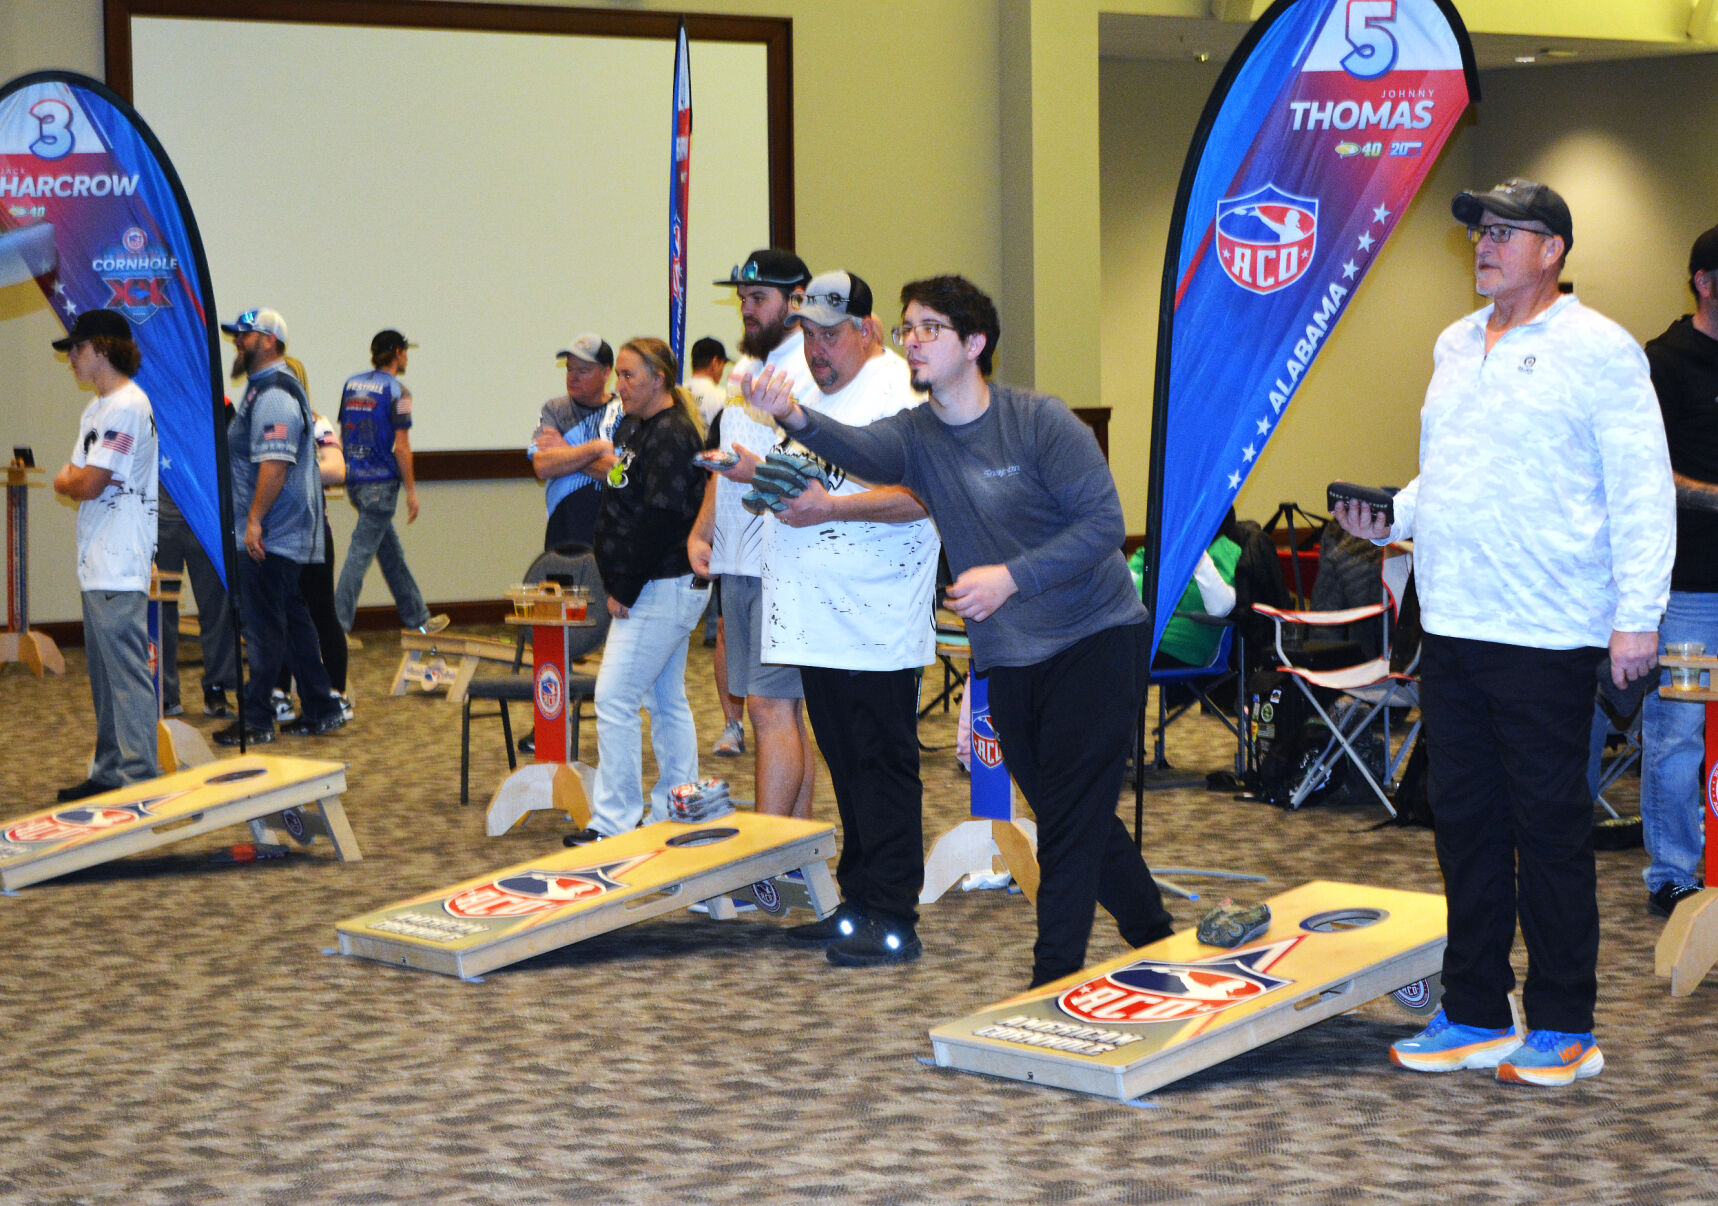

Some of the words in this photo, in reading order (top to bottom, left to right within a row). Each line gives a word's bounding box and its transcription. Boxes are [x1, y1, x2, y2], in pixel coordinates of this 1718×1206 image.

[1339, 0, 1397, 79] 5
[1381, 89, 1435, 99] JOHNNY
[29, 99, 75, 161] 3
[1290, 99, 1435, 131] THOMAS
[0, 174, 140, 198] HARCROW
[92, 258, 178, 271] CORNHOLE
[1268, 282, 1348, 415] ALABAMA
[972, 1025, 1118, 1056] CORNHOLE
[995, 1014, 1146, 1046] AMERICAN
